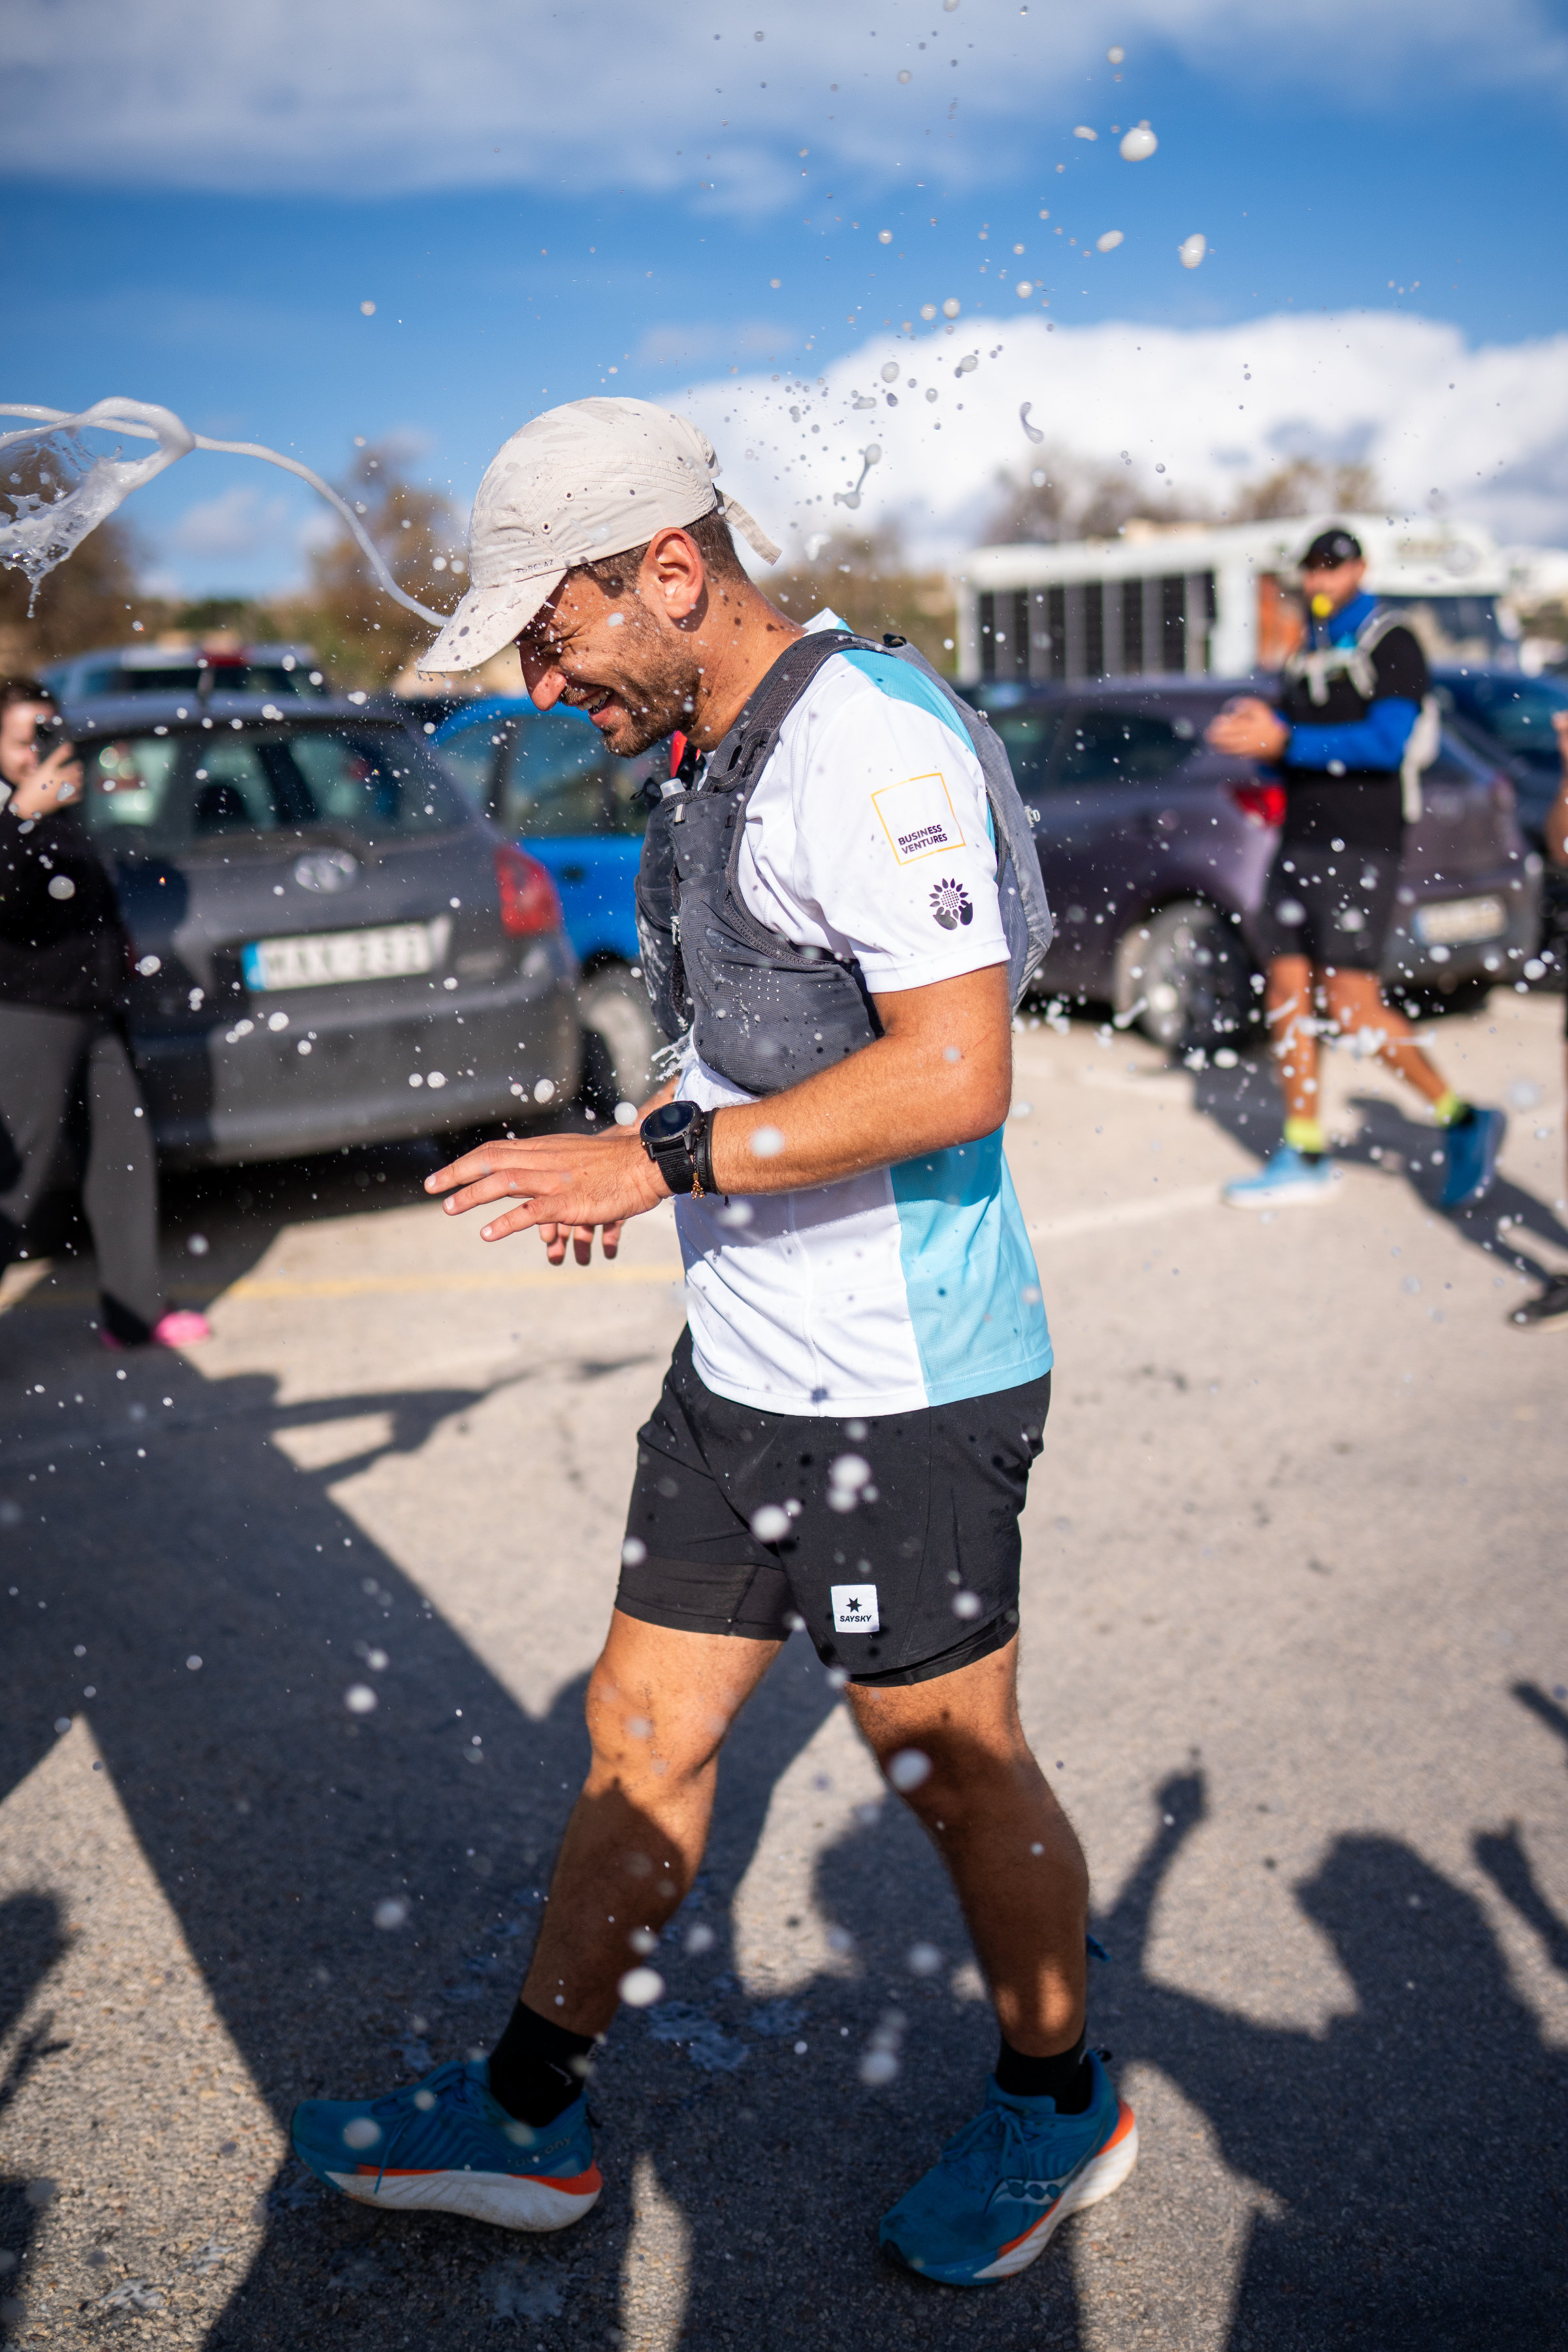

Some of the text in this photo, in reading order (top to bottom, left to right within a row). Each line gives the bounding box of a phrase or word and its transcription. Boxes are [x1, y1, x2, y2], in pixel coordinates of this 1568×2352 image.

[516, 559, 554, 574] FORCAZ
[898, 824, 943, 846] BUSINESS
[901, 833, 948, 855] VENTURES
